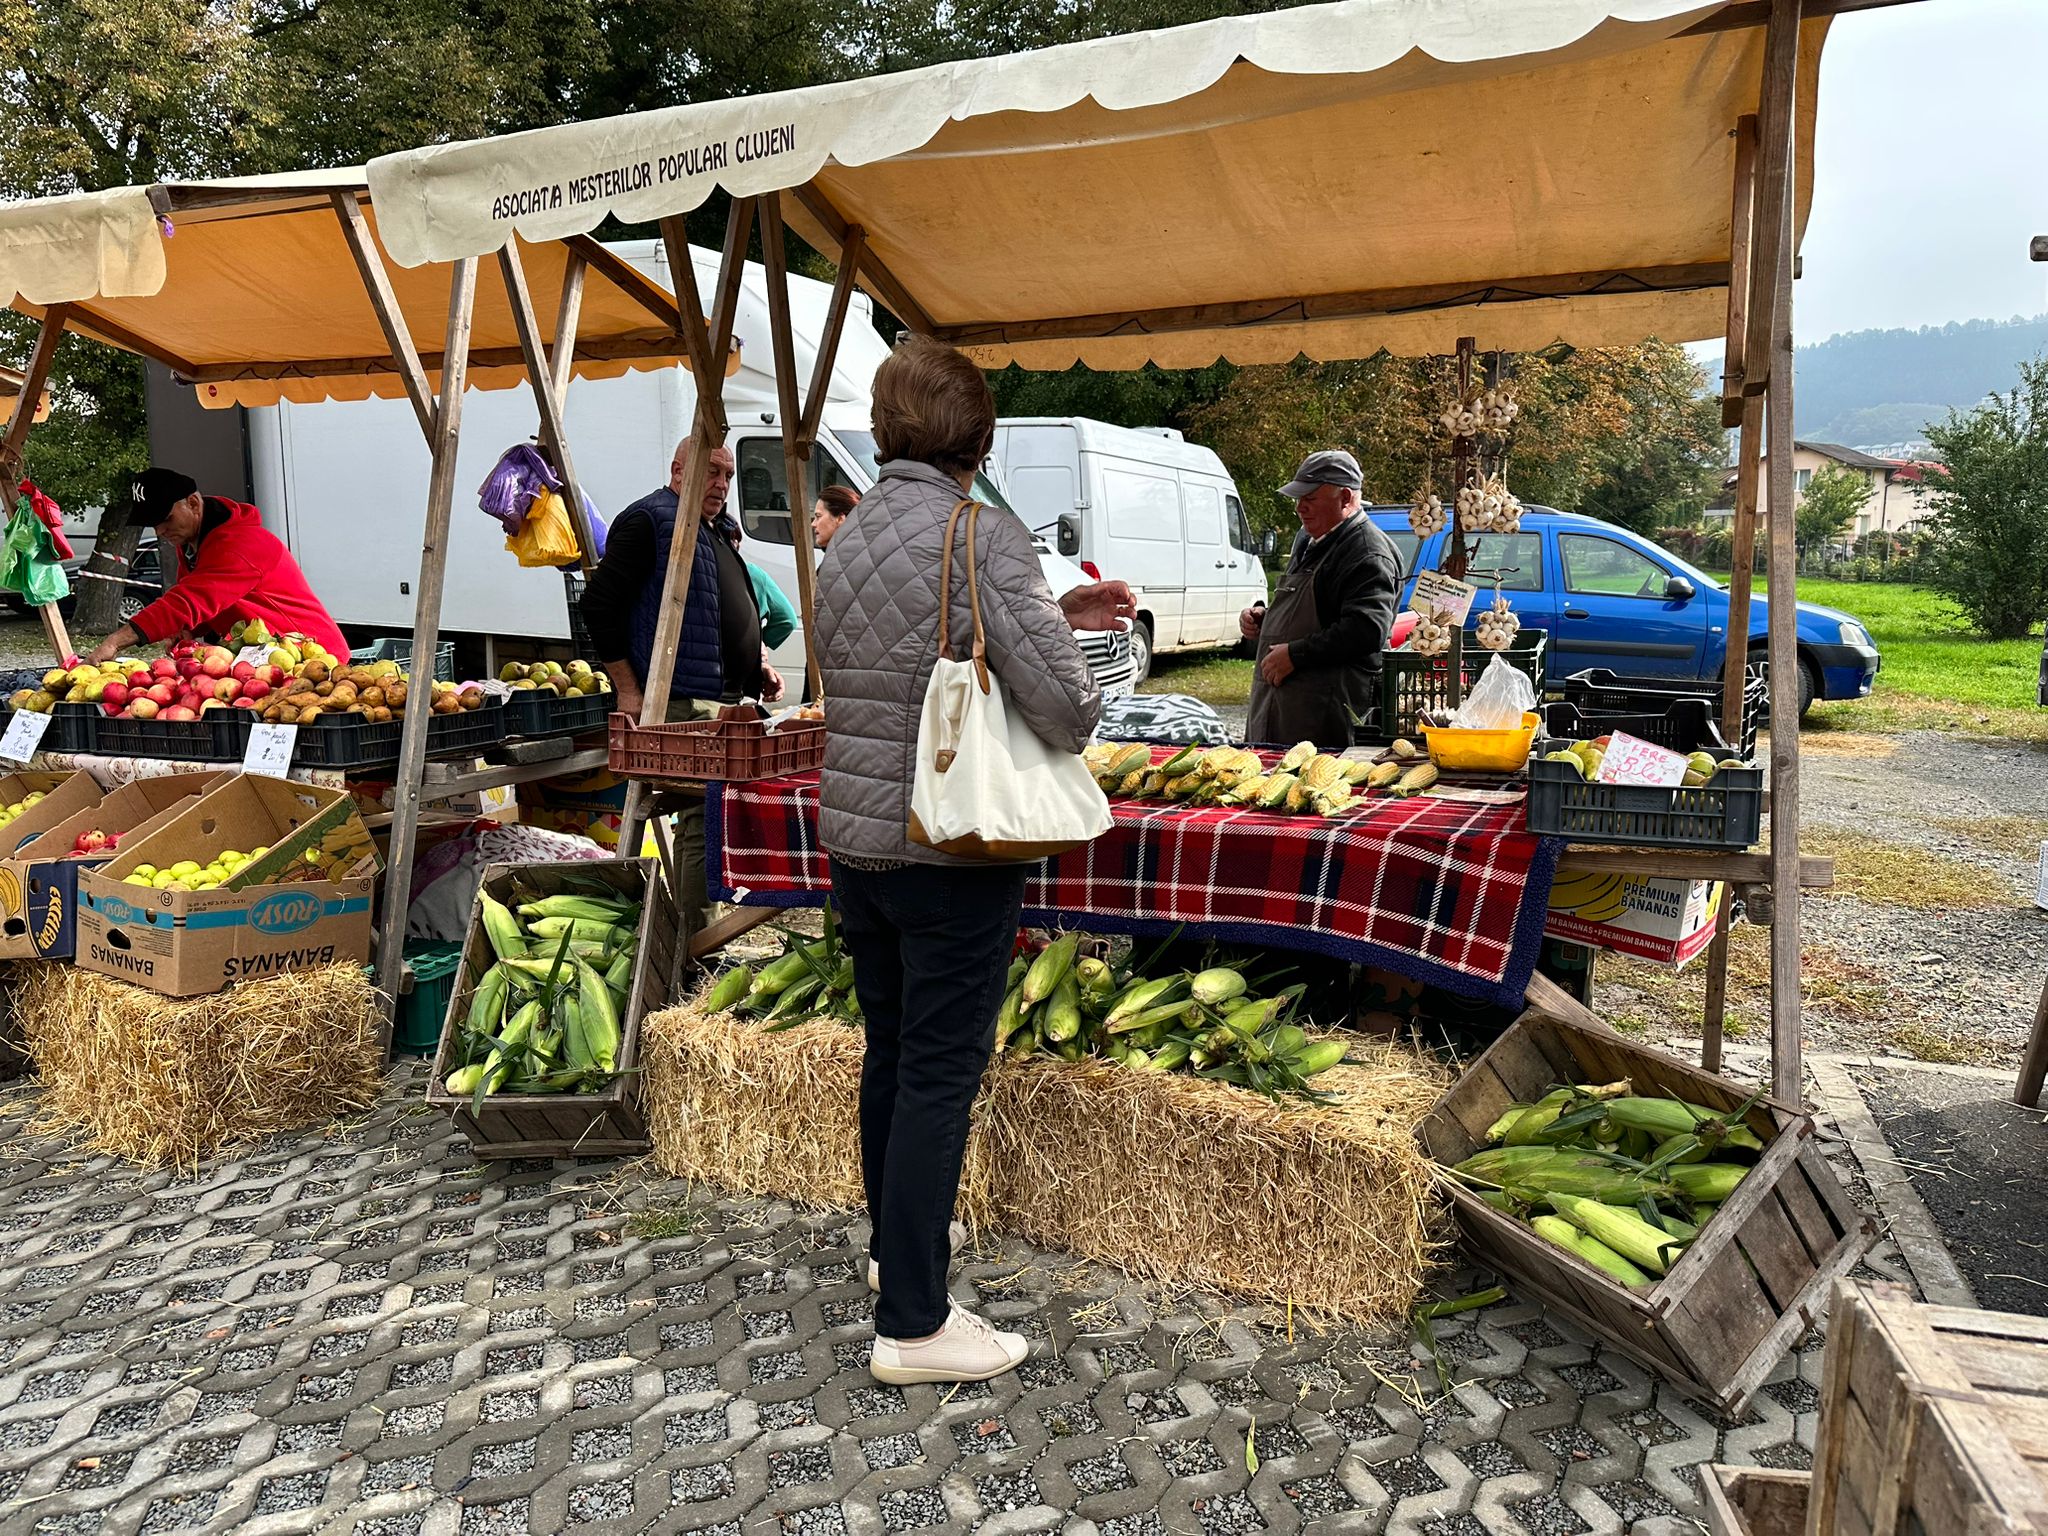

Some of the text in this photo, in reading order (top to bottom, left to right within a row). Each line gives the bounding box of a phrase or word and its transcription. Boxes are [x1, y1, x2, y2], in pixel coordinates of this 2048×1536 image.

[569, 161, 653, 205] MESTERILOR
[658, 141, 728, 184] POPULARI
[735, 123, 795, 164] CLUJENI
[1620, 895, 1679, 919] BANANAS
[1623, 881, 1681, 905] PREMIUM
[257, 899, 316, 926] ROSY
[1557, 918, 1594, 935] BANANAS
[1597, 929, 1634, 945] PREMIUM
[1633, 937, 1672, 953] BANANAS
[90, 943, 155, 977] BANANAS
[223, 945, 336, 977] BANANAS
